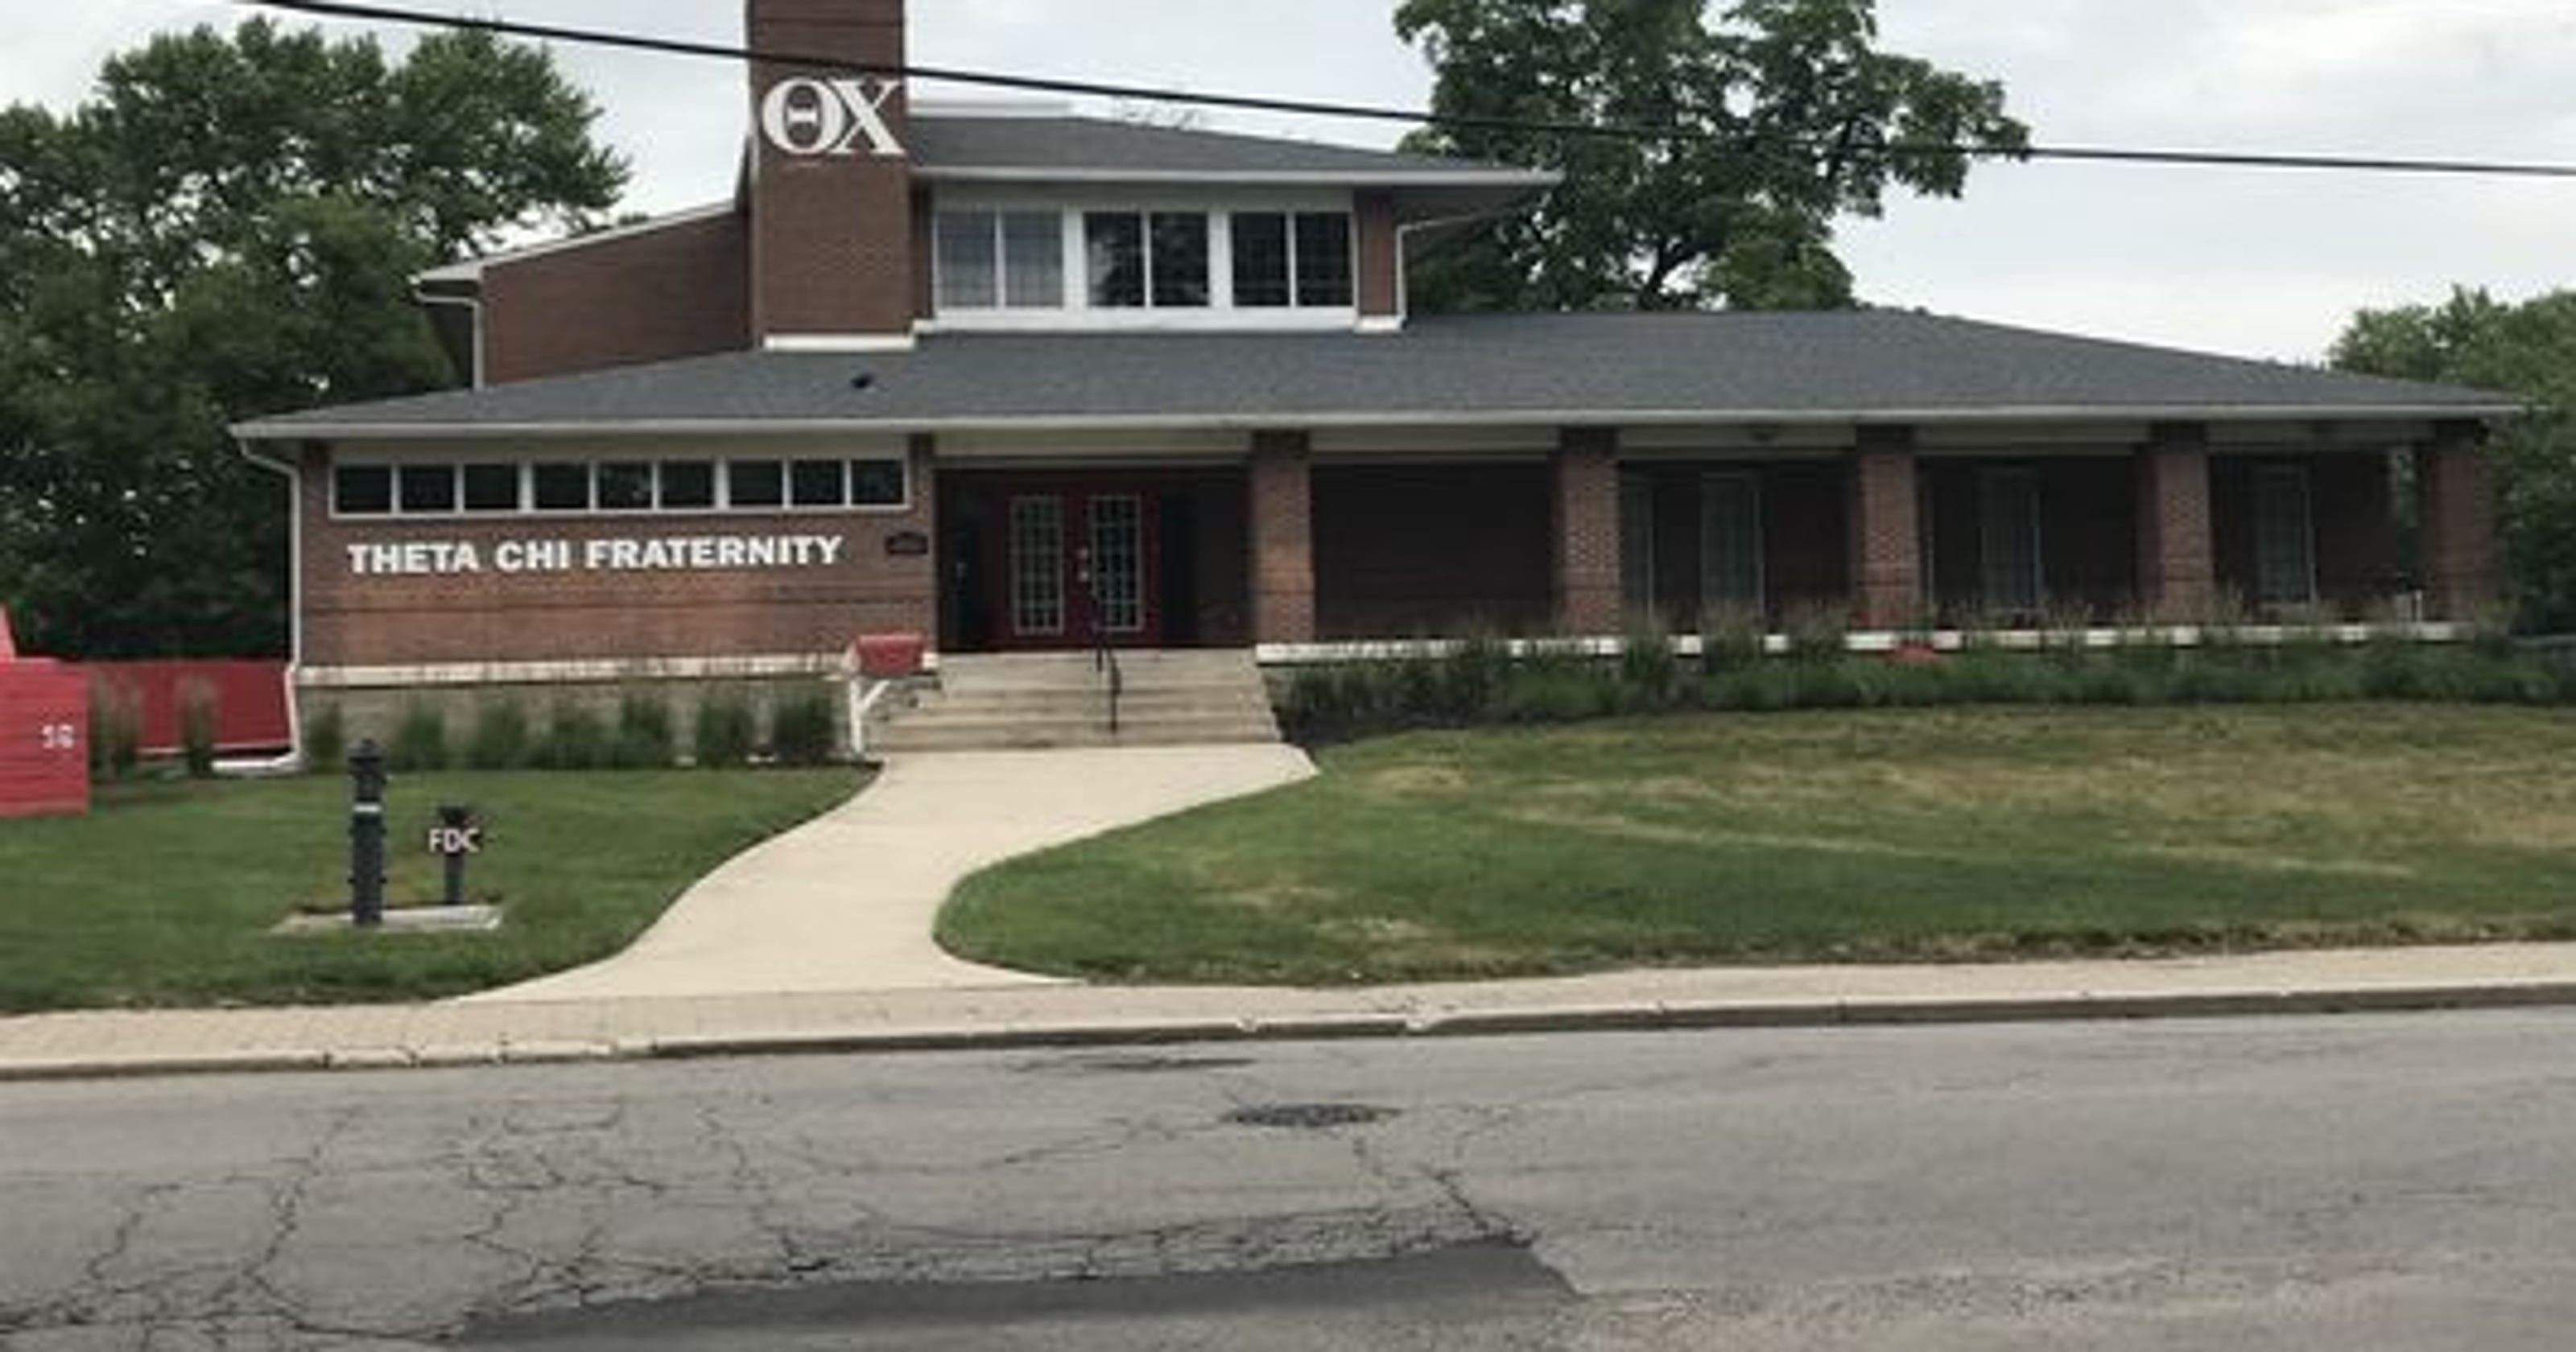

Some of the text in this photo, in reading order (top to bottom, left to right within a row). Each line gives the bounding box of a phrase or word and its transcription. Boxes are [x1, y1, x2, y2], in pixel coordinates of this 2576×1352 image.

[346, 535, 842, 573] THETA CHI FRATERNITY
[429, 828, 479, 853] FDC
